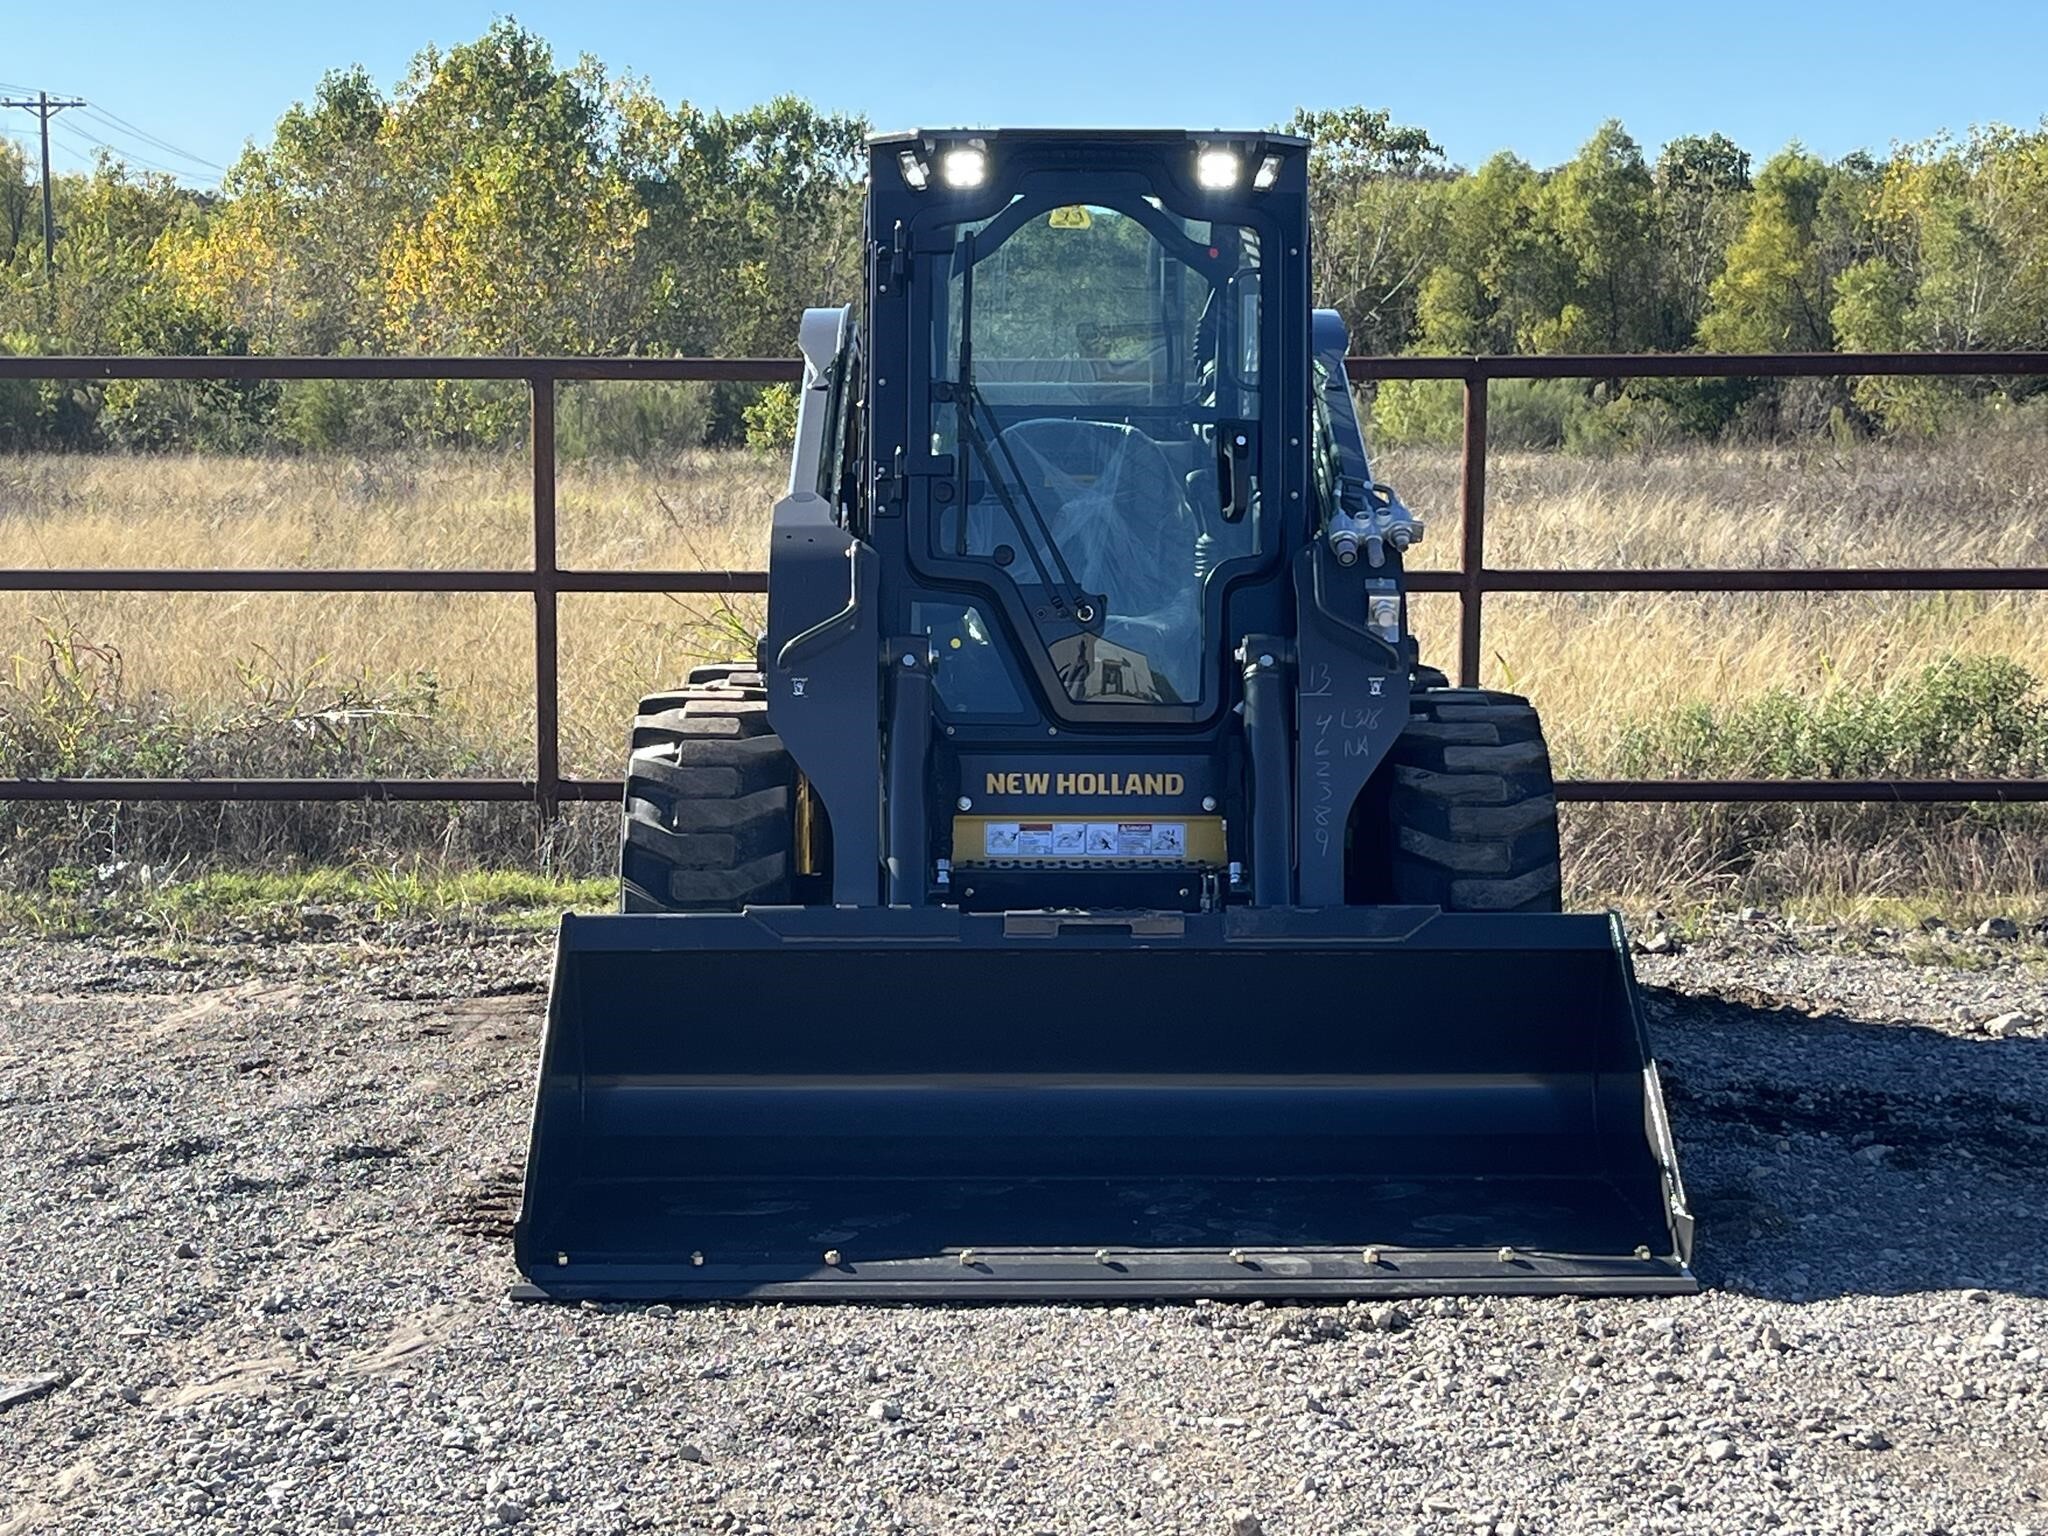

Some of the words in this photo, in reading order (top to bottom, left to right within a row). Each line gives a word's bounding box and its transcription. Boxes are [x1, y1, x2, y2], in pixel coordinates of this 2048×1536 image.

[1309, 663, 1332, 694] 13
[986, 773, 1050, 795] NEW
[1056, 773, 1185, 796] HOLLAND
